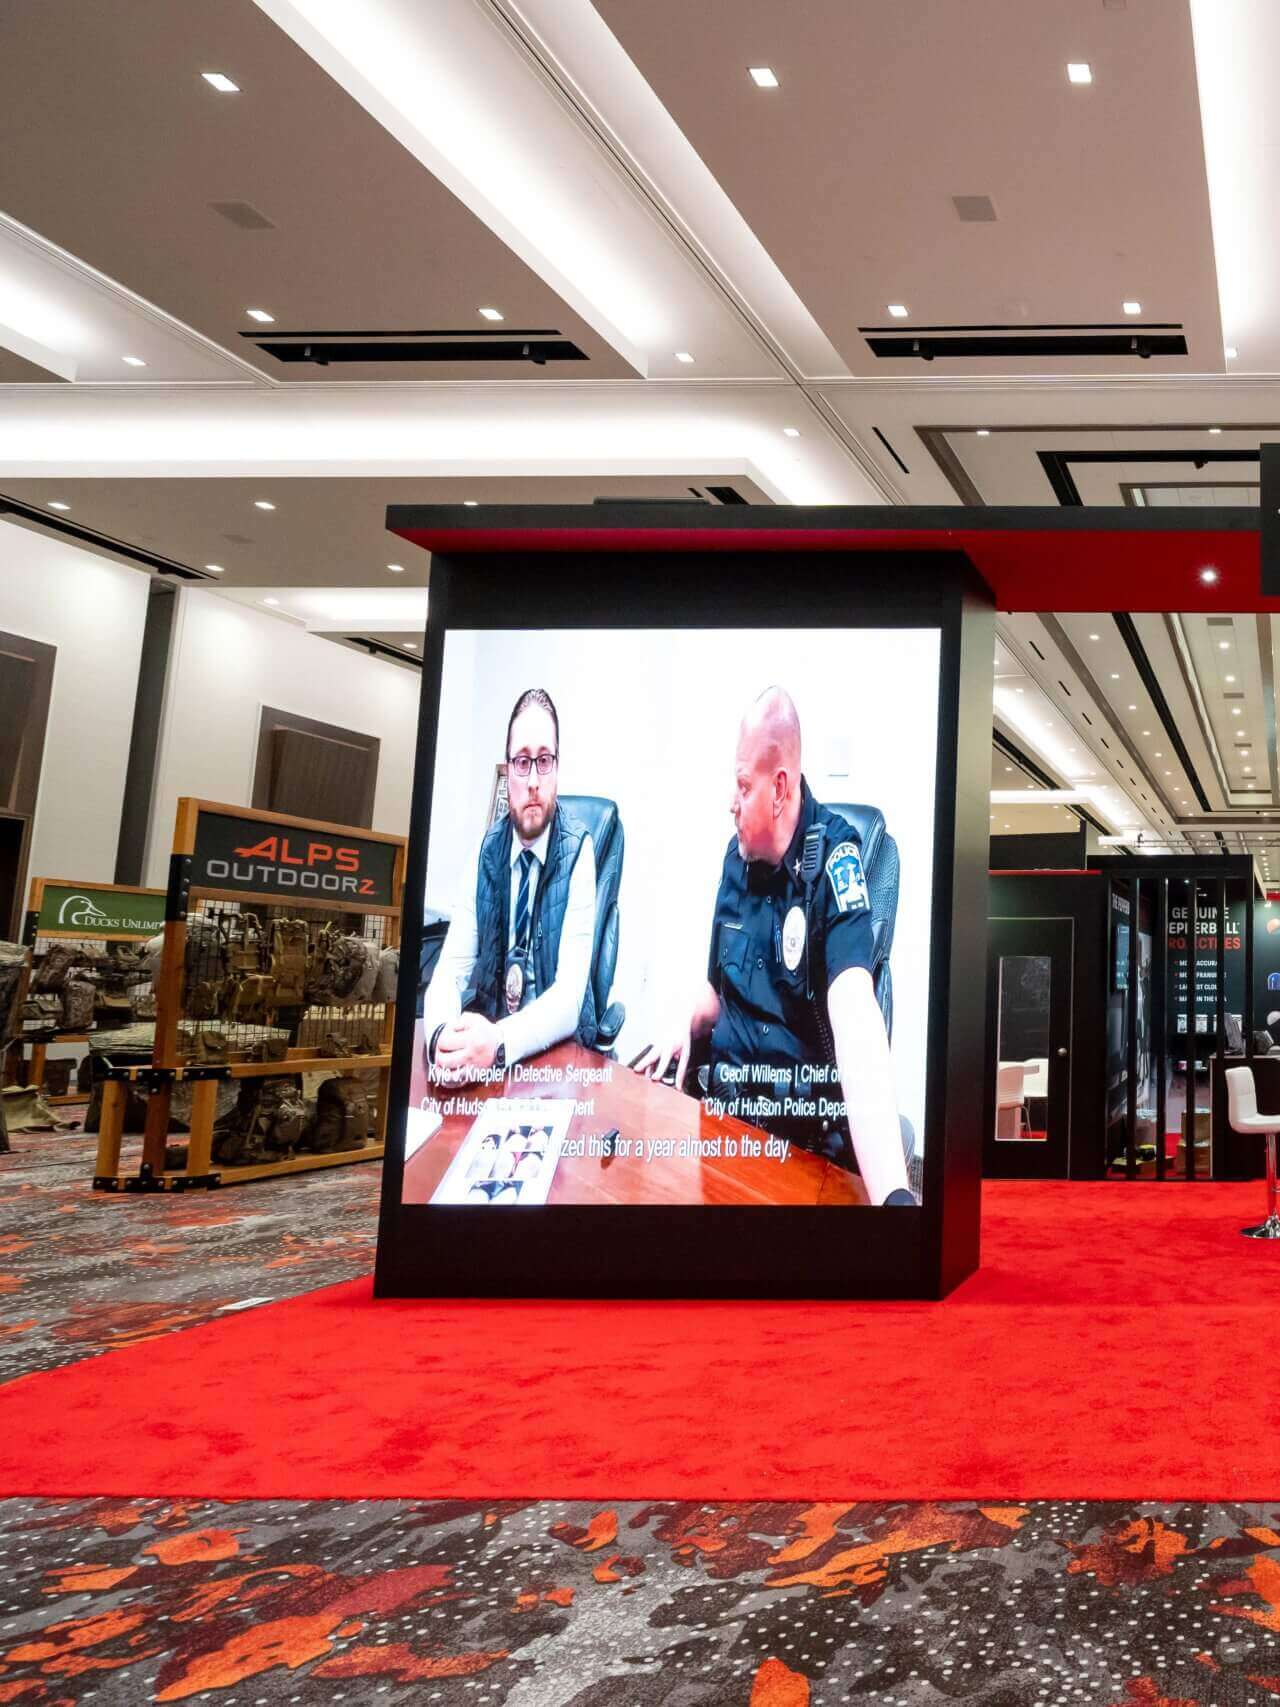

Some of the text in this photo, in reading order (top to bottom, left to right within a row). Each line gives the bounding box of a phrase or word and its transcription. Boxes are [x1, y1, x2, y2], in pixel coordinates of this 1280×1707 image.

[232, 836, 360, 872] ALPS
[83, 916, 161, 930] DUCKS UNLIMI
[428, 1065, 450, 1087] Kyle
[465, 1065, 506, 1087] Knepler
[514, 1065, 563, 1082] Detective
[565, 1065, 613, 1087] Sergeant
[720, 1064, 749, 1082] Geoff
[751, 1064, 792, 1082] Willems
[801, 1064, 829, 1082] Chief
[420, 1097, 486, 1120] City of Huds
[705, 1097, 725, 1120] City
[728, 1097, 739, 1115] of
[741, 1098, 781, 1115] Hudson
[784, 1098, 815, 1115] Police
[588, 1135, 611, 1158] this
[614, 1135, 632, 1158] for
[636, 1140, 643, 1158] a
[647, 1139, 675, 1162] year
[678, 1135, 723, 1158] almost
[725, 1136, 737, 1158] to
[741, 1135, 761, 1158] the
[765, 1135, 792, 1162] day.
